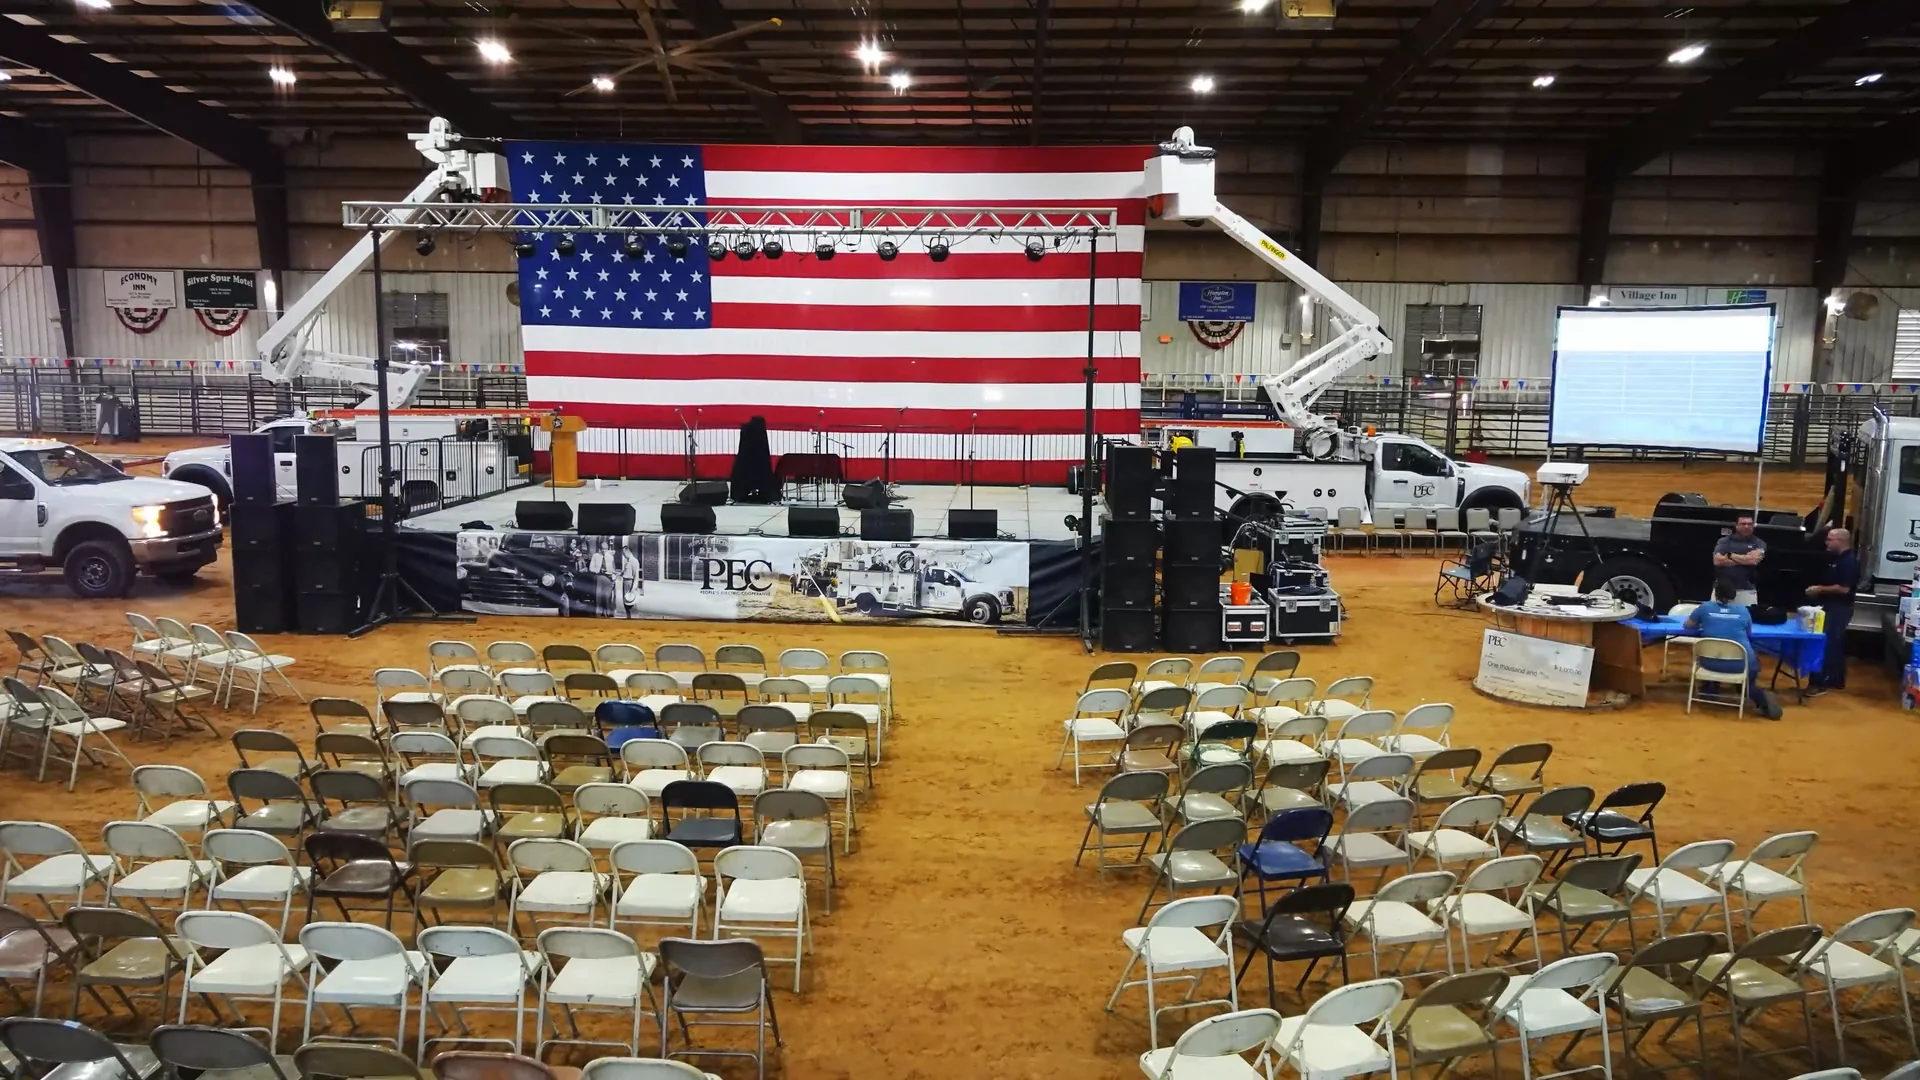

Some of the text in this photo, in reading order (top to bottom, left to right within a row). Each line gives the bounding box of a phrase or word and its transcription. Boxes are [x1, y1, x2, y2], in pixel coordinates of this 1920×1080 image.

[120, 272, 157, 286] ECONOMY
[187, 273, 253, 288] Silver Spur Motel
[1205, 288, 1230, 297] Hampton
[1620, 290, 1677, 301] Village Inn
[1413, 483, 1436, 498] PEC
[699, 558, 773, 592] PEC
[1487, 634, 1507, 648] PEC
[1487, 660, 1499, 670] One
[1499, 663, 1526, 675] thousand
[1526, 667, 1538, 677] and
